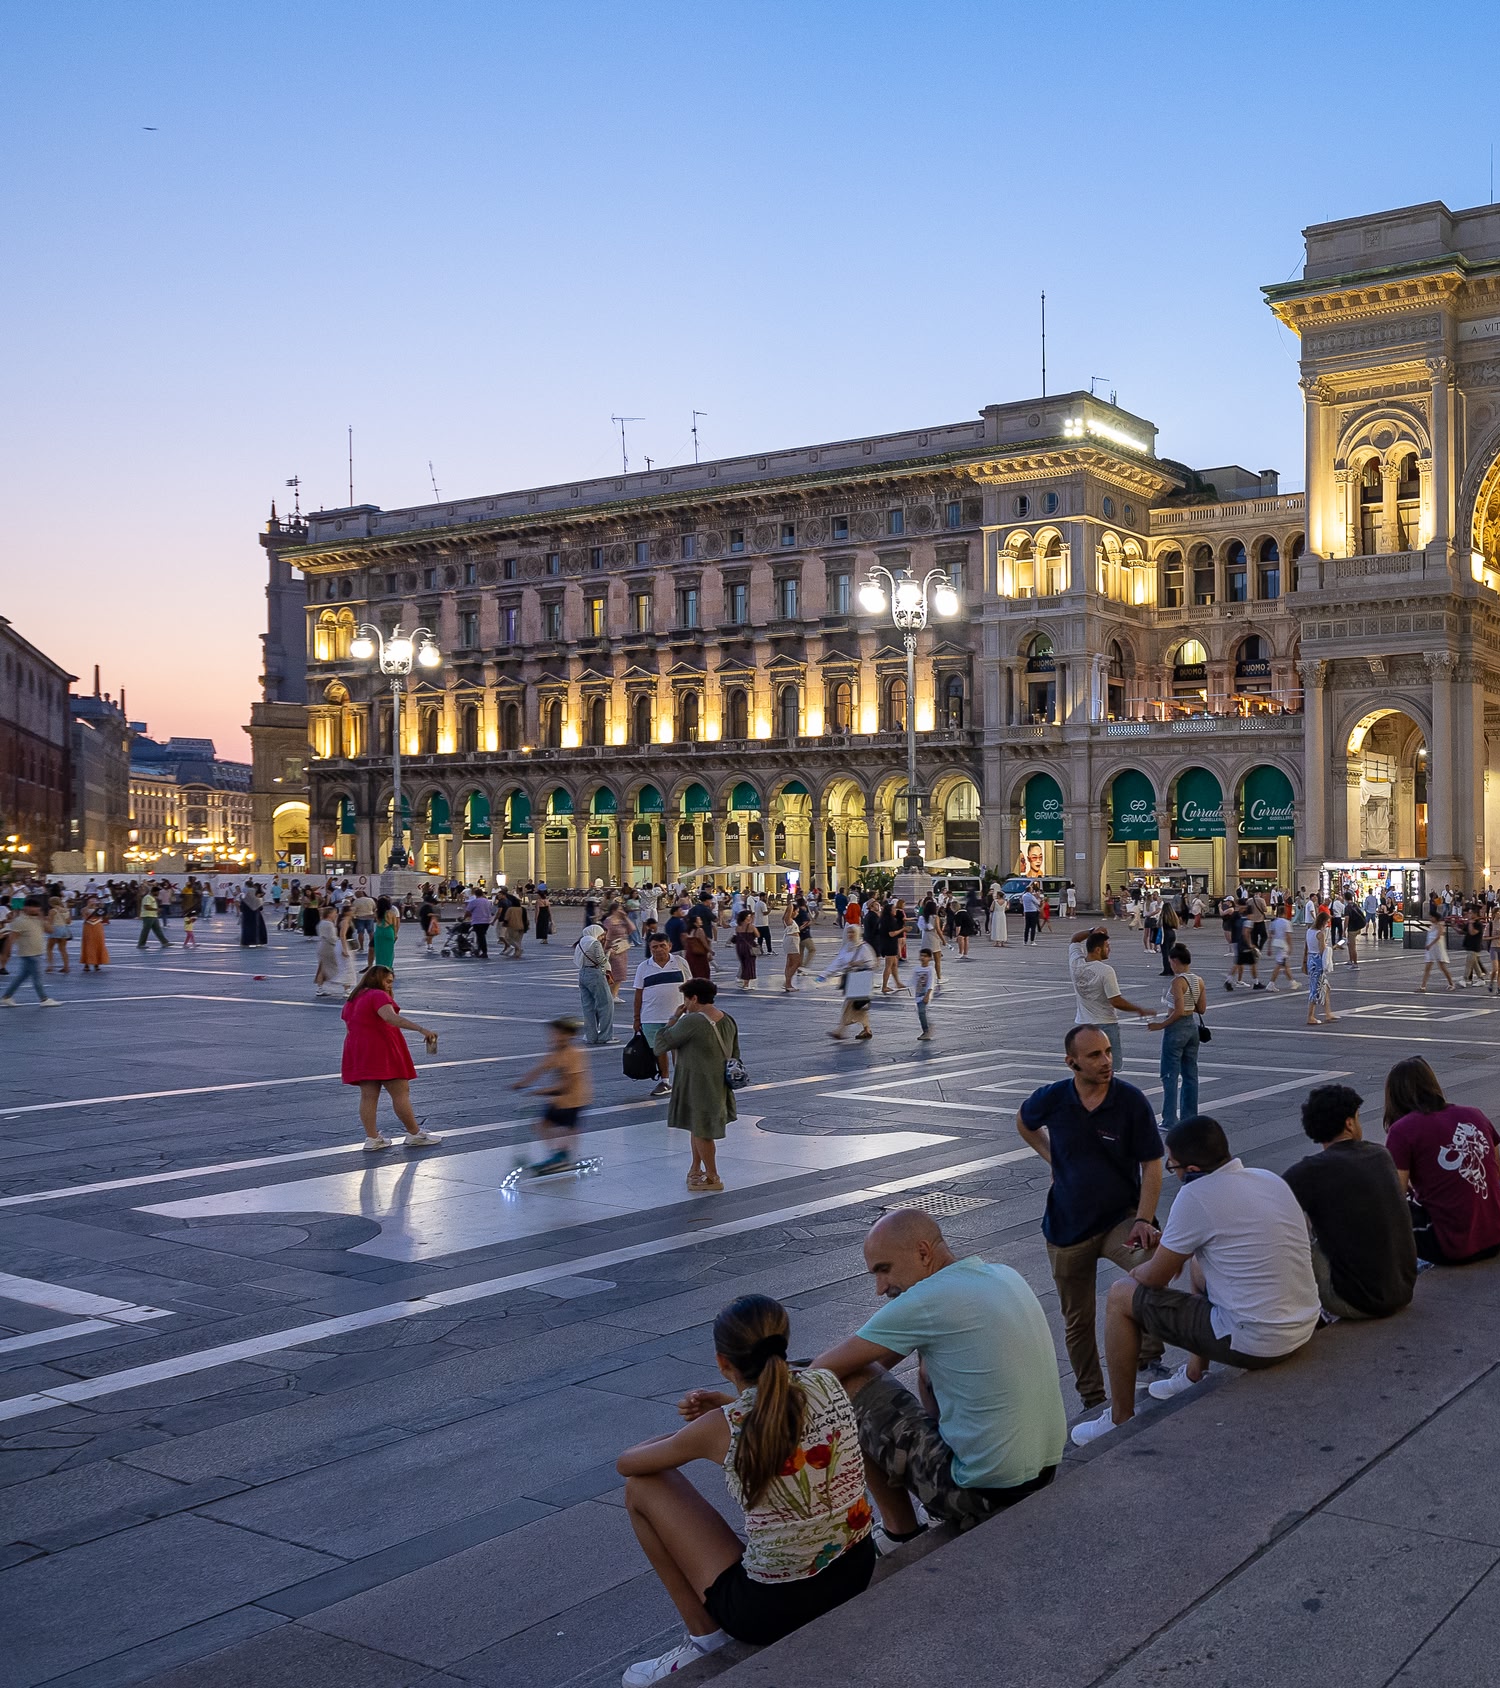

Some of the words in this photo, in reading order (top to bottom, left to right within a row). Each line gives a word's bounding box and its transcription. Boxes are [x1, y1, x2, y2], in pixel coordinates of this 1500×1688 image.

[1471, 326, 1478, 335] A
[1180, 668, 1202, 676] DUOMO
[1242, 664, 1264, 672] DUOMO
[1182, 800, 1224, 822] Currad
